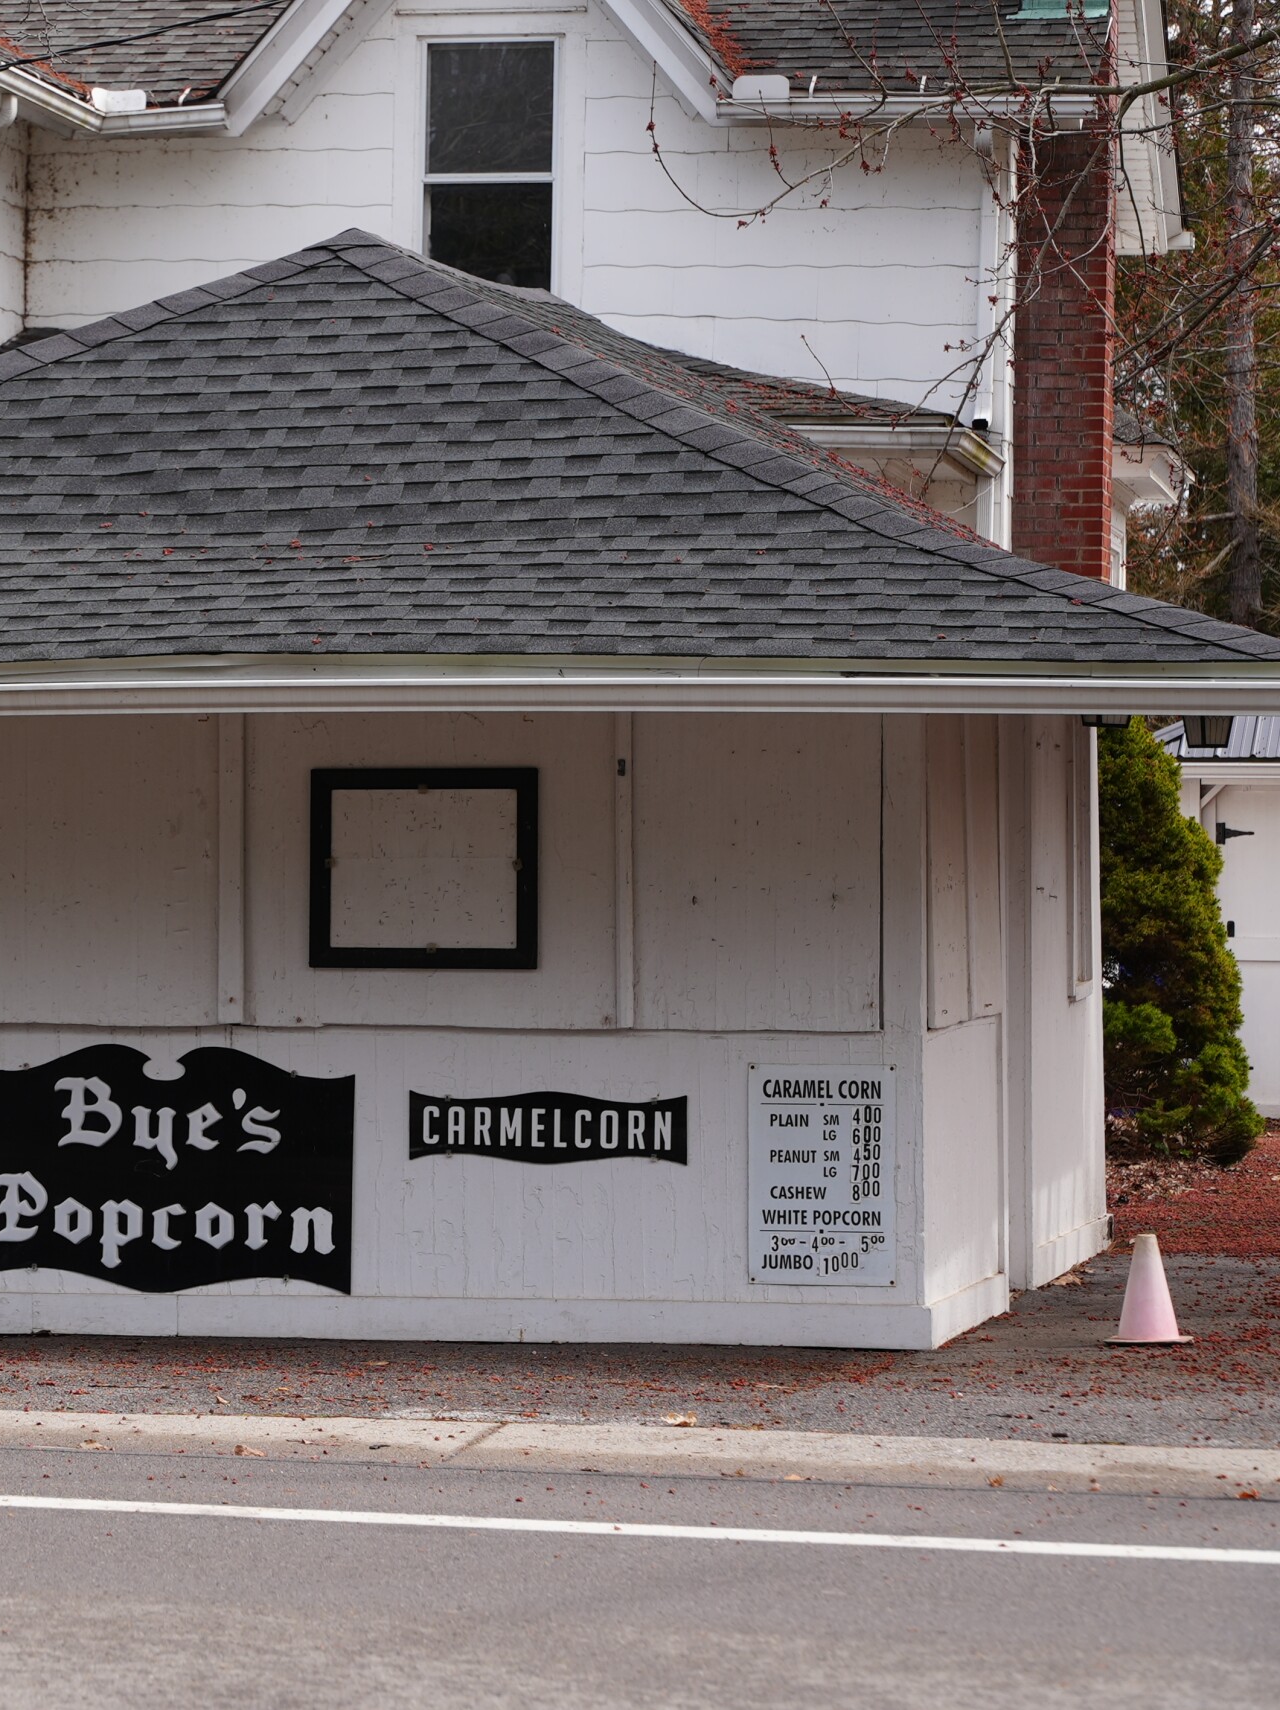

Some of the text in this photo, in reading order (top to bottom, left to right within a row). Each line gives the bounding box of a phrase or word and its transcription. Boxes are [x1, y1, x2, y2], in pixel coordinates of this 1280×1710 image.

[762, 1079, 881, 1099] CARAMEL CORN
[54, 1076, 282, 1170] Bye's
[770, 1114, 809, 1127] PLAIN
[823, 1114, 839, 1126] SM
[423, 1105, 672, 1151] CARMELCORN
[823, 1130, 837, 1141] LG
[770, 1150, 817, 1163] PEANUT
[823, 1151, 840, 1162] SM
[823, 1166, 837, 1178] LG
[770, 1186, 827, 1200] CASHEW
[762, 1210, 881, 1226] WHITE POPCORN
[761, 1254, 813, 1269] JUMBO
